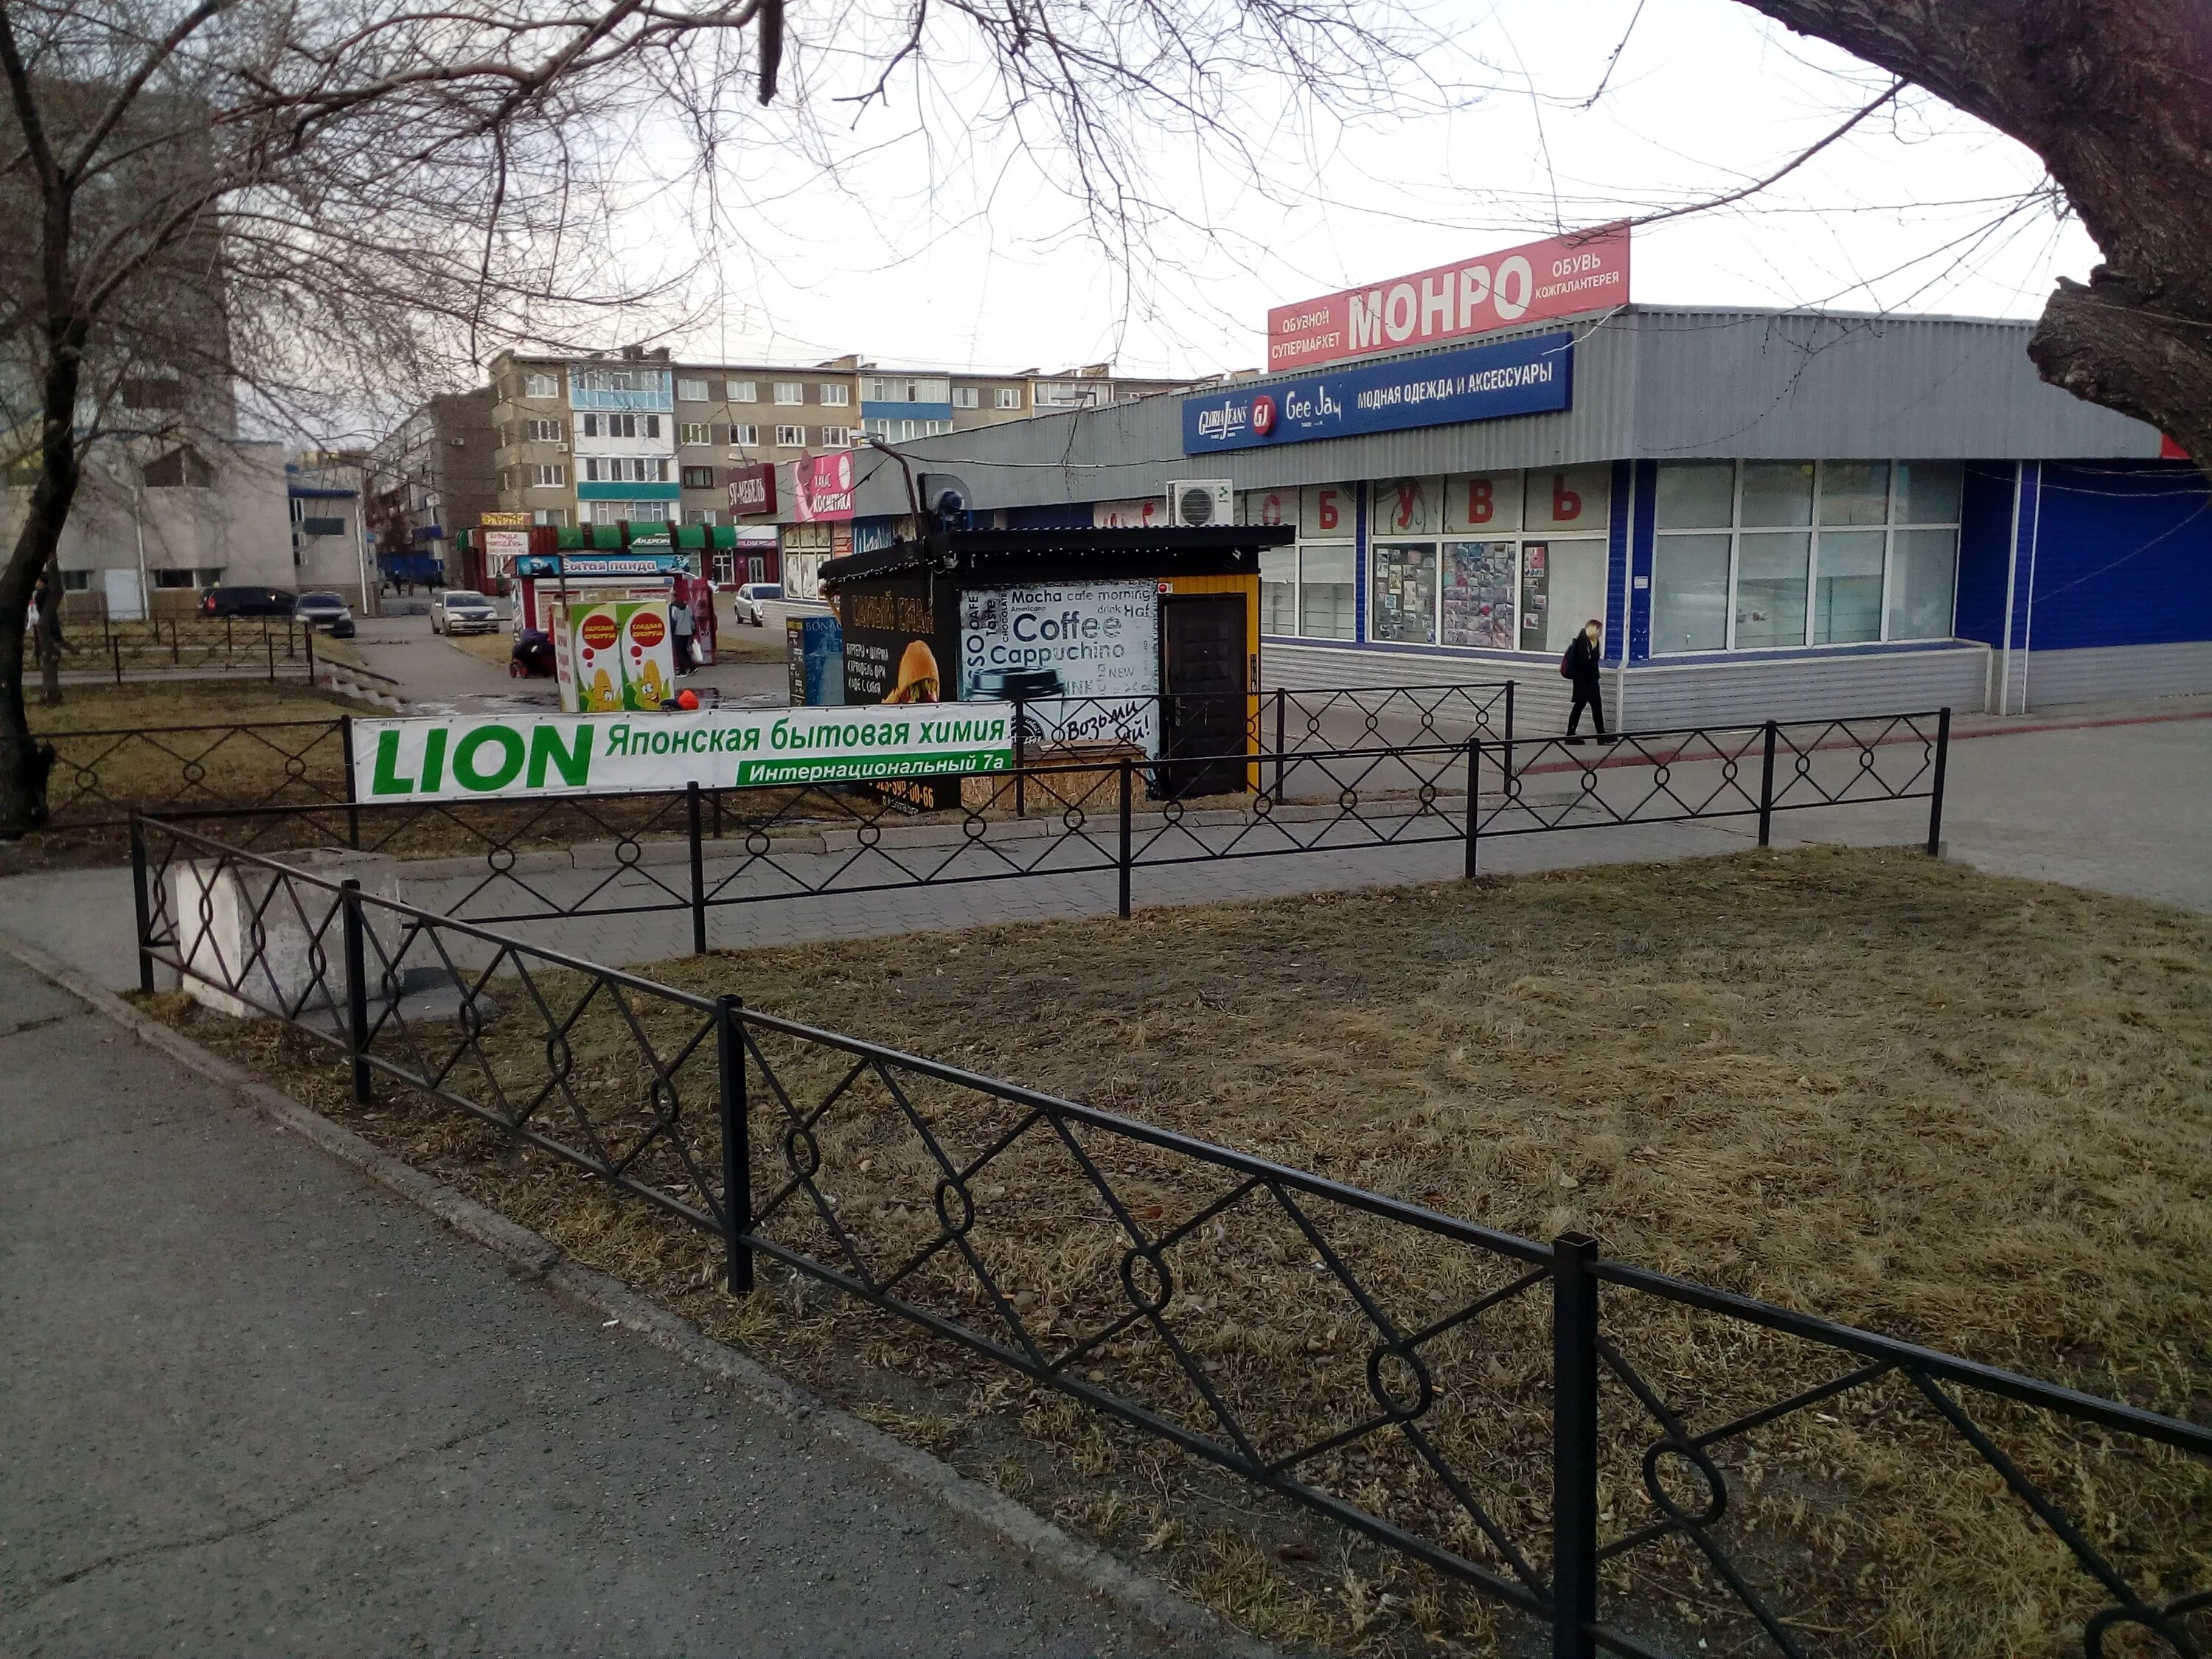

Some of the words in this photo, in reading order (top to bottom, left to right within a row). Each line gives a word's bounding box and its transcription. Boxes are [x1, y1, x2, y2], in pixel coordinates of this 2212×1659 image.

[1552, 252, 1601, 279] ОБУВЬ
[1534, 271, 1620, 301] КОЖГАЛАНТЕРЕЯ
[1348, 254, 1533, 351] МОНРО
[1282, 307, 1330, 335] ОБУВНОЙ
[1272, 332, 1341, 361] СУПЕРМАРКЕТ
[1357, 386, 1402, 410] МОДНАЯ
[1404, 378, 1453, 405] ОДЕЖДА
[1457, 377, 1465, 395] И
[1468, 361, 1552, 393] АКСЕССУАРЫ
[1286, 391, 1311, 420] Gee
[1315, 386, 1342, 422] Jay
[610, 560, 657, 574] панда
[1012, 590, 1062, 604] Mocha
[1067, 590, 1093, 601] cafe
[1099, 590, 1150, 602] morning
[1013, 611, 1121, 642] Coffee
[990, 641, 1125, 667] Cappuchino
[605, 723, 761, 757] Японская
[771, 717, 910, 750] бытовая
[918, 719, 1006, 745] химия
[372, 723, 595, 796] LION
[748, 754, 977, 783] Интернациональный
[983, 755, 1004, 771] 7а
